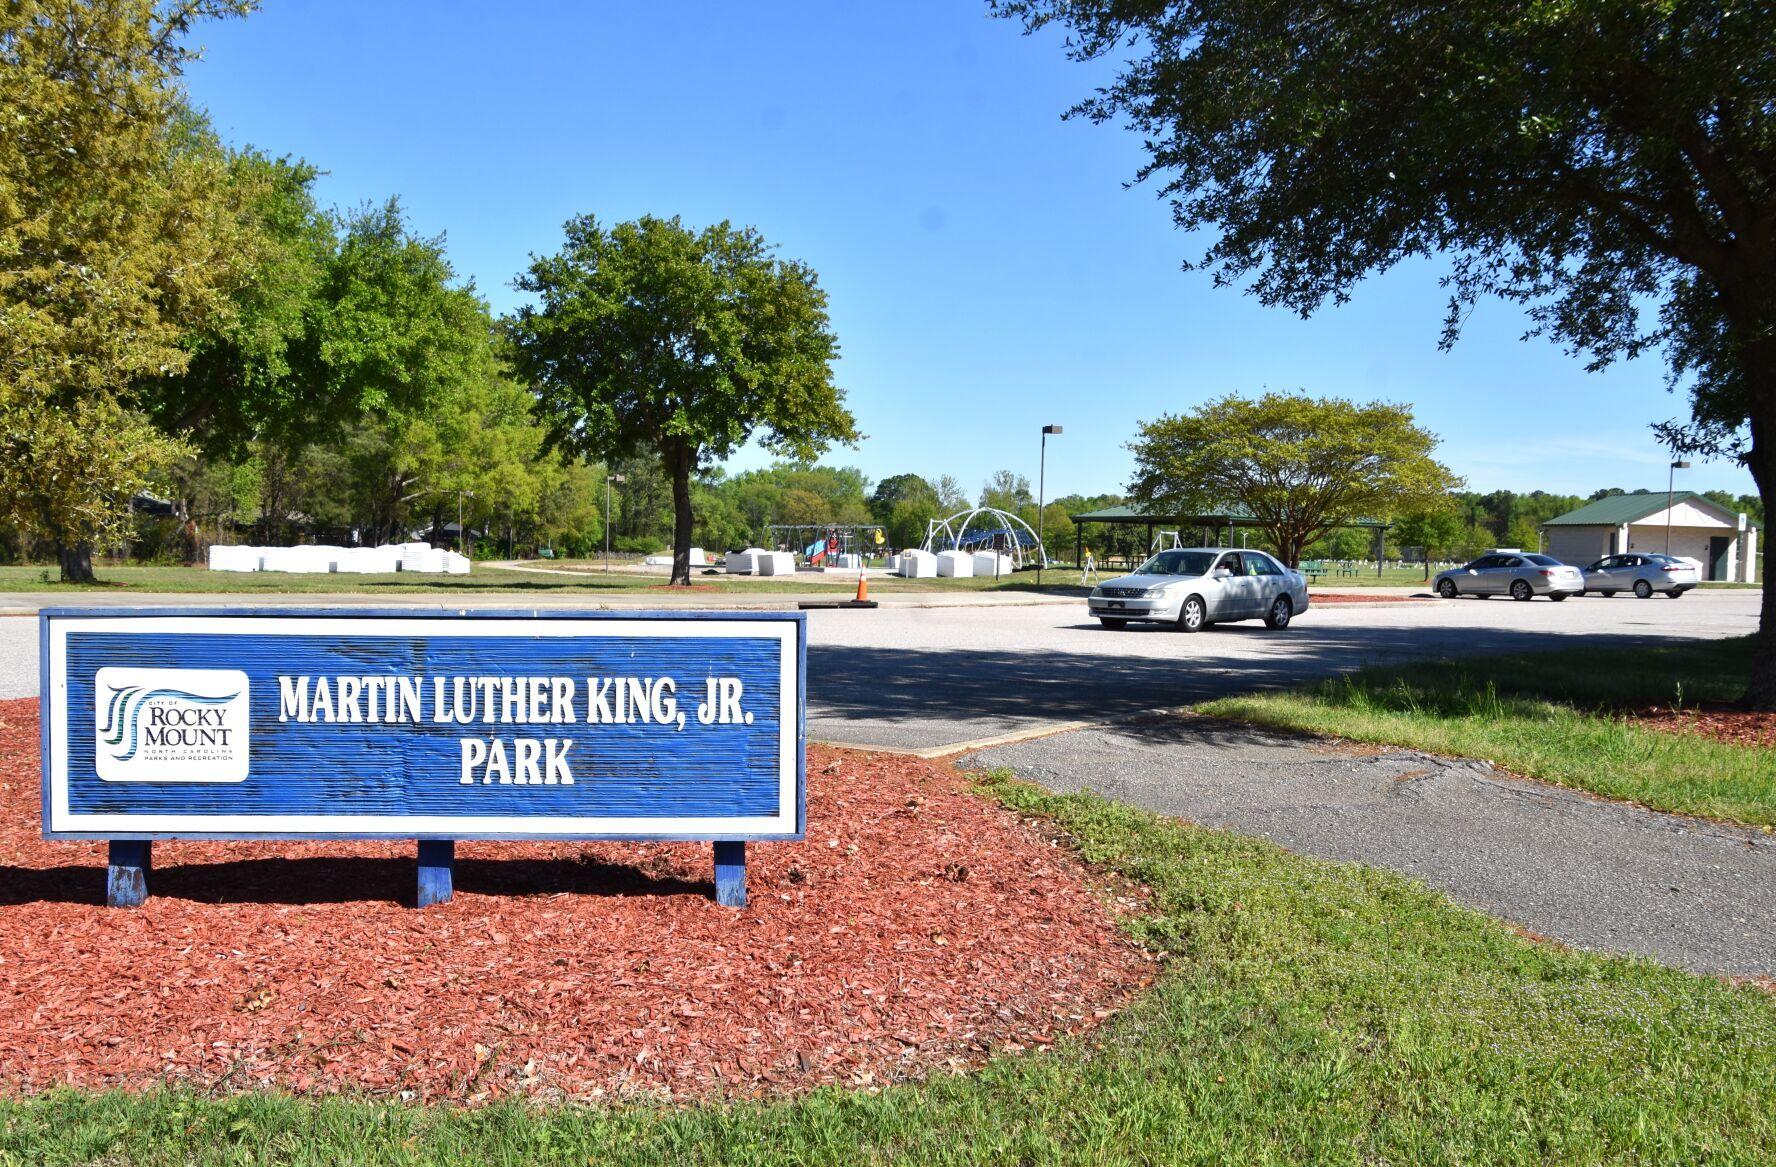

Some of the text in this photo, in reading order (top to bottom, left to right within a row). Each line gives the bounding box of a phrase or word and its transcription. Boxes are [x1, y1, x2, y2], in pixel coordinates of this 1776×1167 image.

[150, 707, 227, 726] ROCKY
[278, 676, 754, 731] MARTIN LUTHER KING, JR.
[144, 727, 232, 746] MOUNT
[459, 738, 576, 785] PARK
